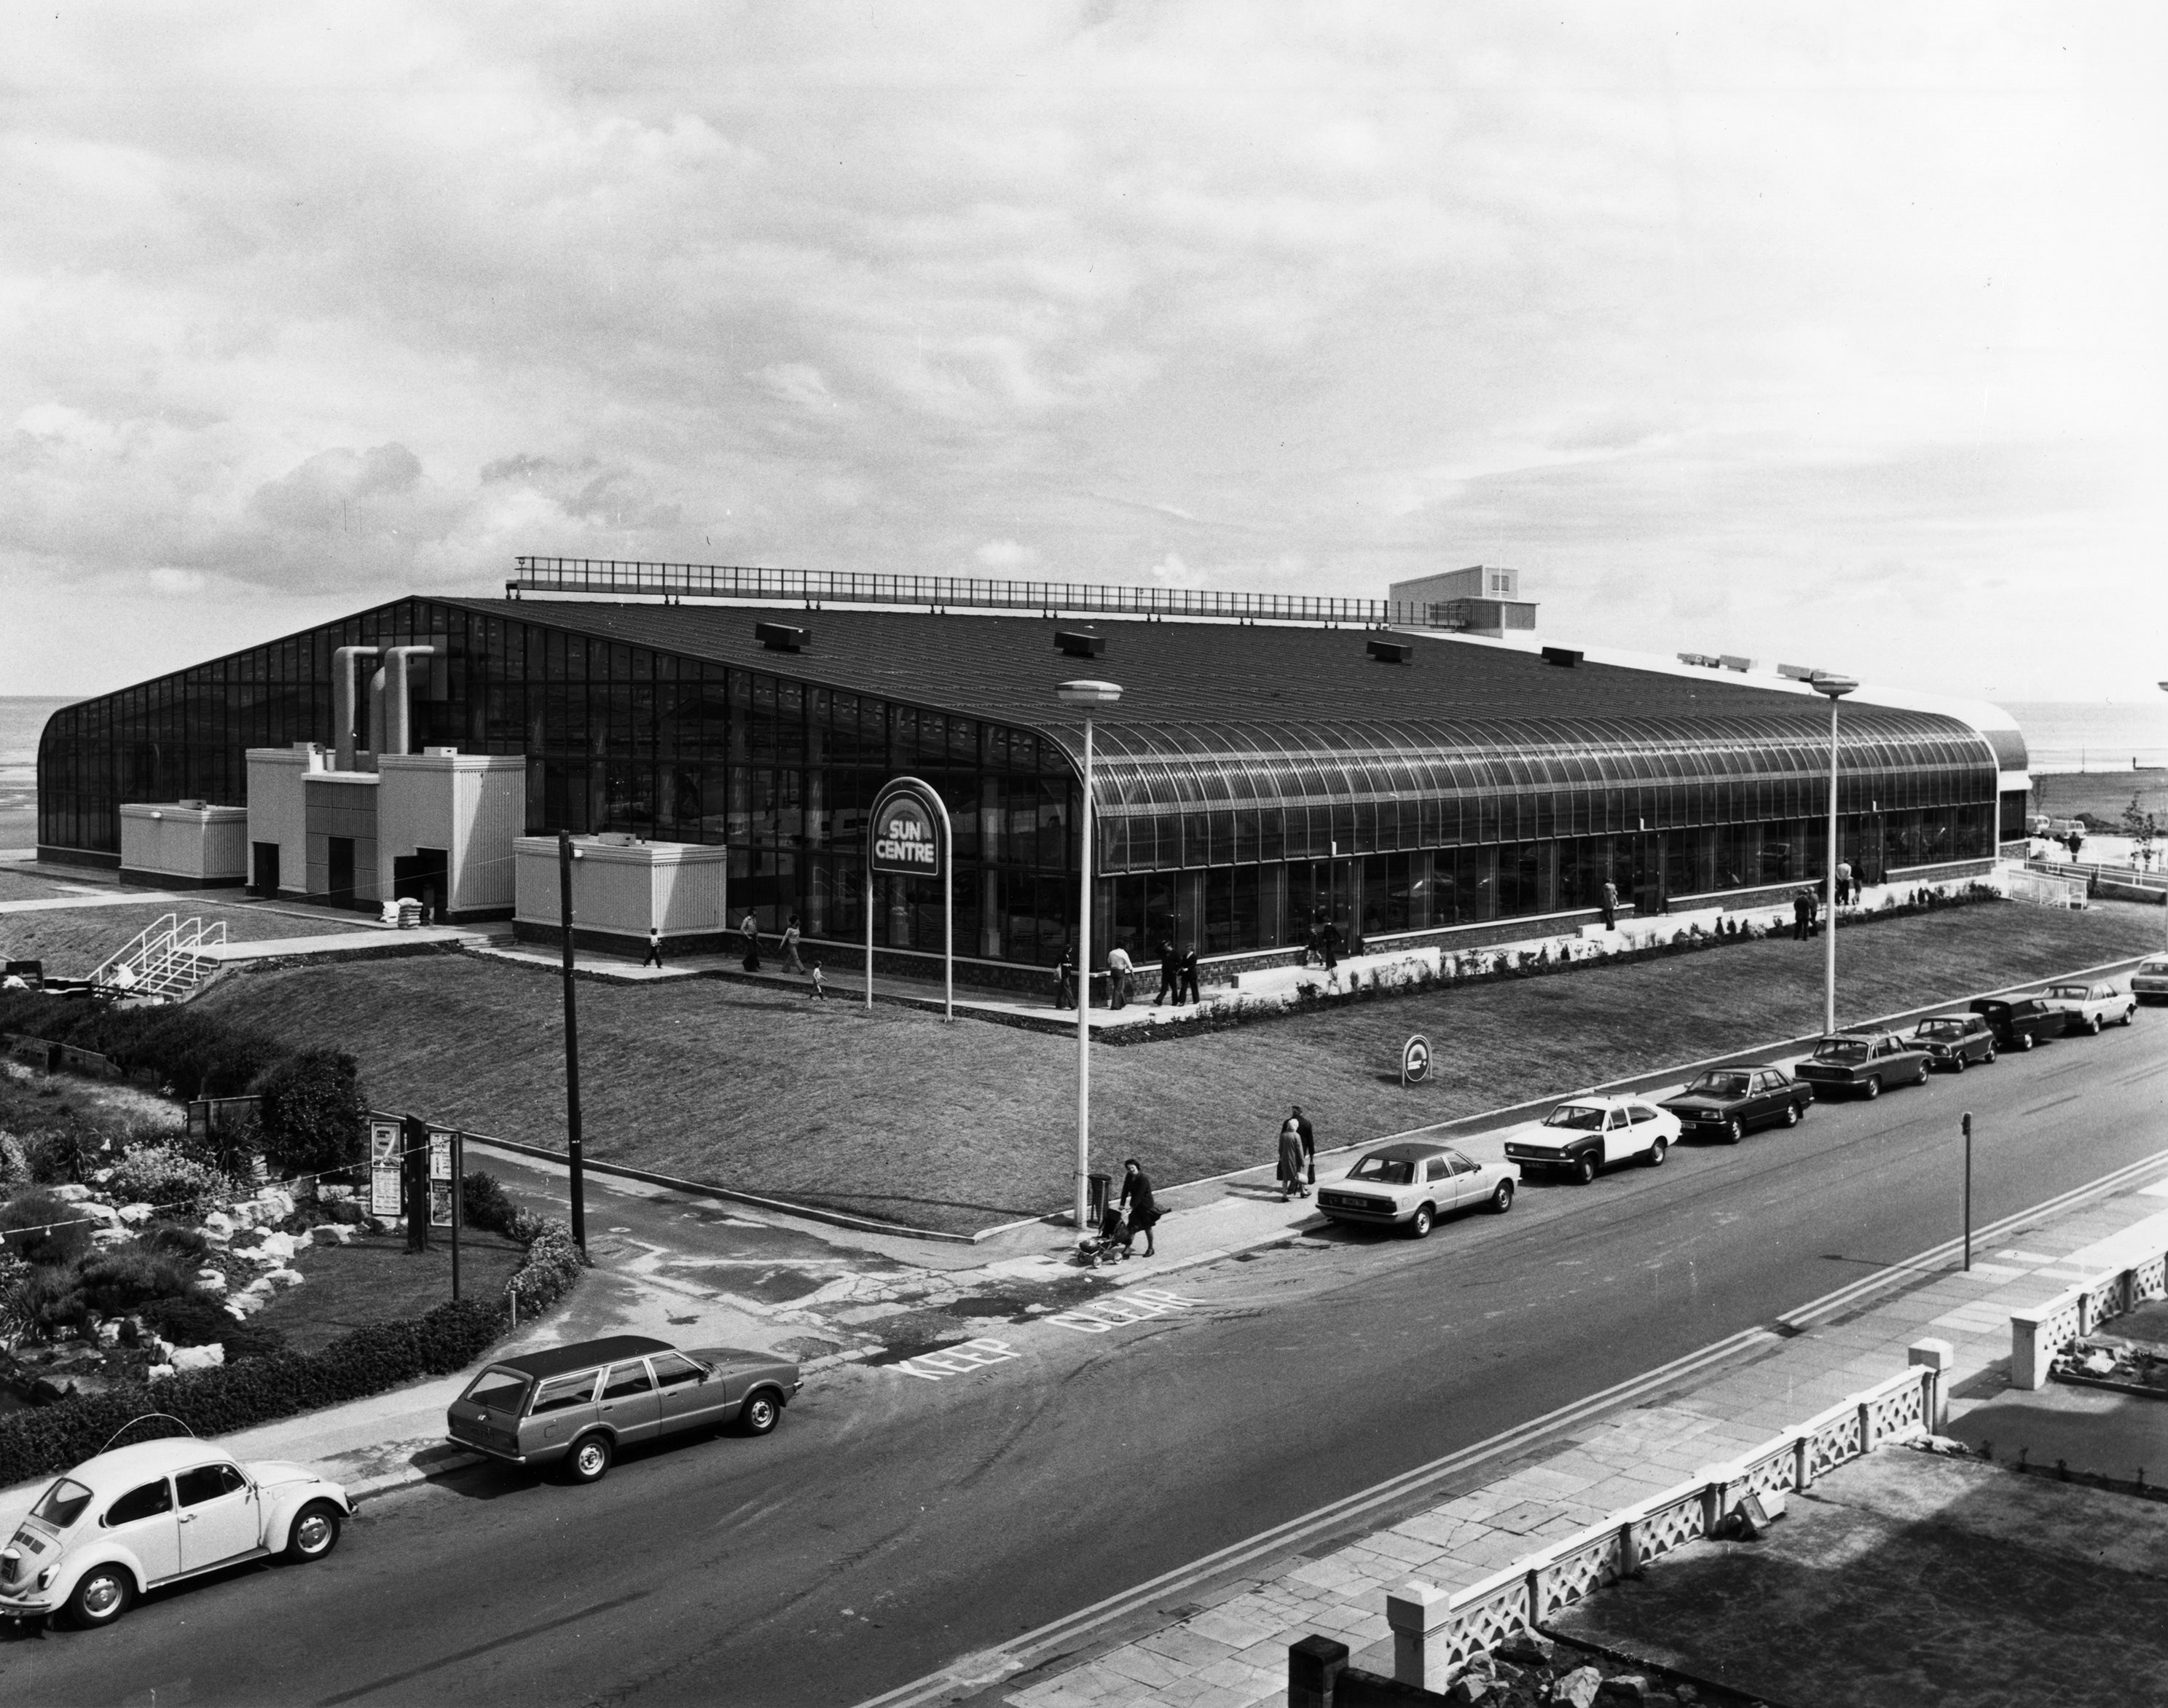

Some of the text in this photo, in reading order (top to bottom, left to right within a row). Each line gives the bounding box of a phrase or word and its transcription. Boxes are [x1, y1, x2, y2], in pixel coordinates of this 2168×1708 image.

[889, 819, 921, 841] SUN
[876, 840, 935, 863] CENTRE
[881, 1288, 1206, 1381] KEEP CLEAR
